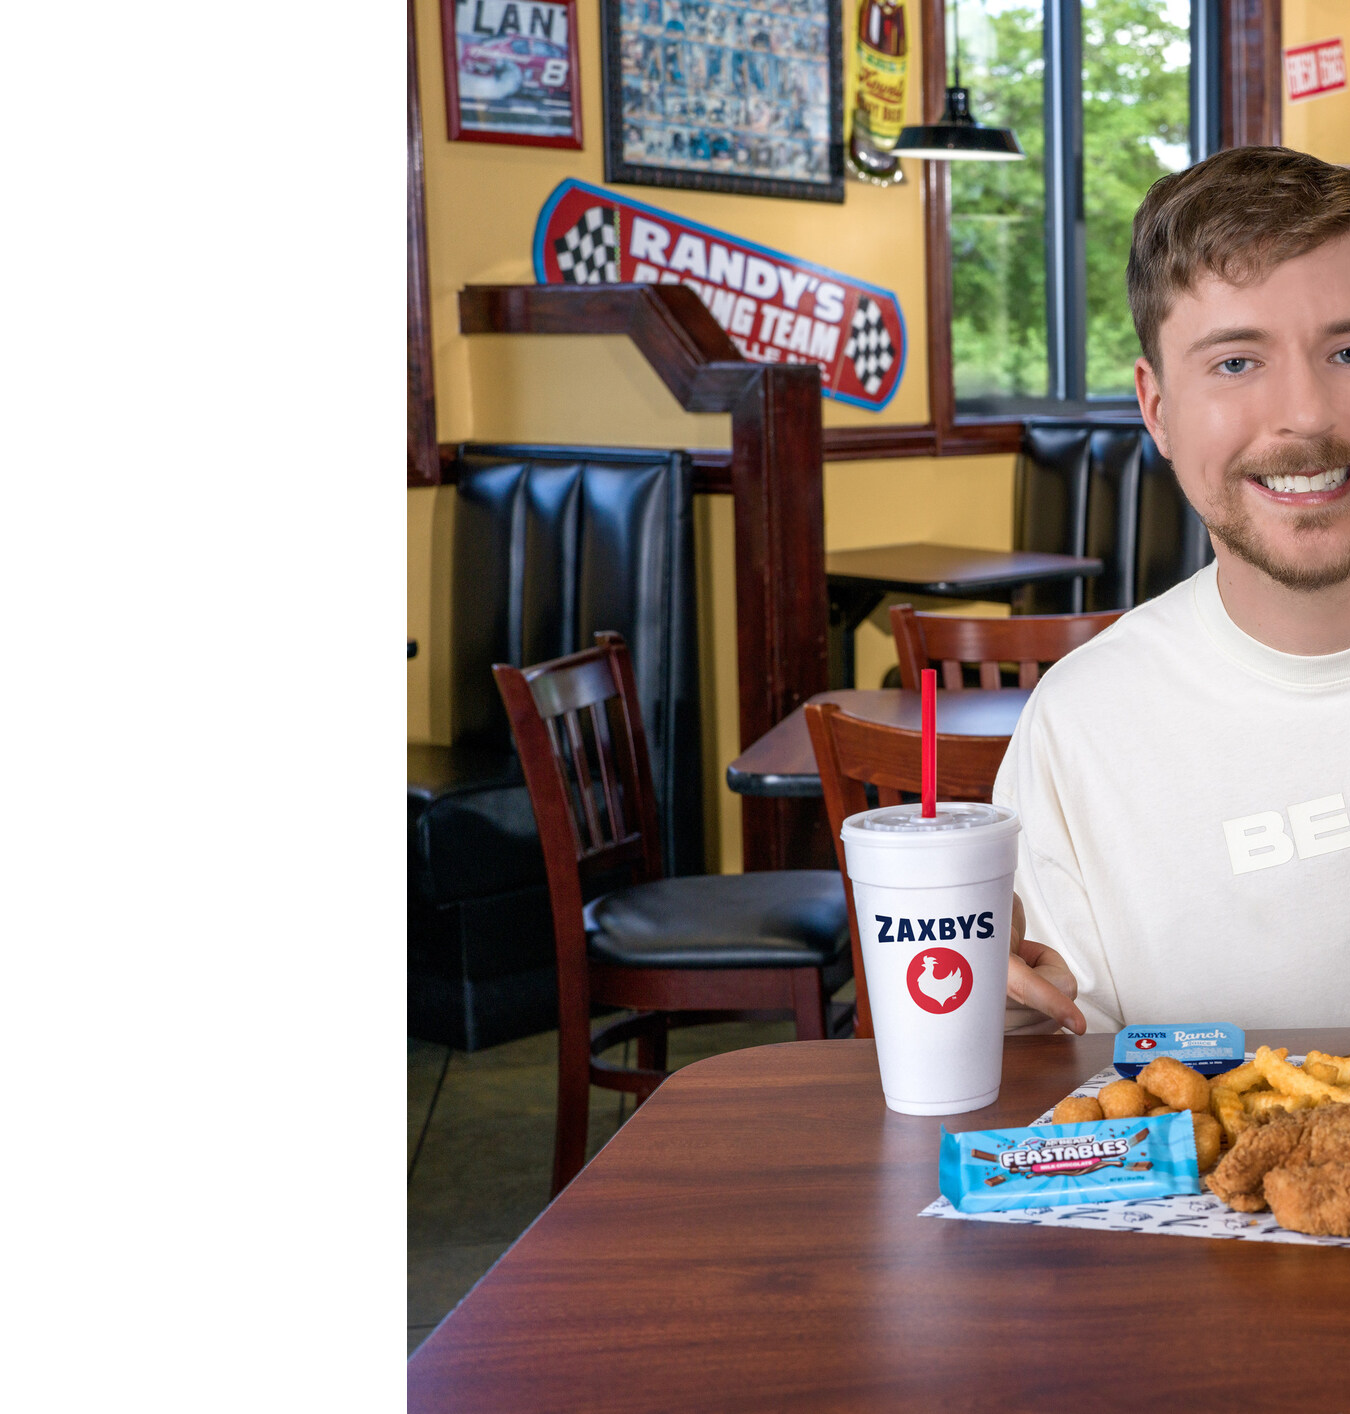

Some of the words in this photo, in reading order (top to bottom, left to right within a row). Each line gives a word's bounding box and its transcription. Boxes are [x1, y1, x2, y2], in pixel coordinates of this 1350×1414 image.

[457, 0, 567, 38] LAN
[542, 59, 568, 87] 8
[629, 216, 845, 324] RANDY'S
[758, 303, 841, 363] TEAM
[875, 911, 995, 943] ZAXBYS
[1173, 1029, 1228, 1042] Ranch
[1002, 1139, 1127, 1167] FEASTABLES
